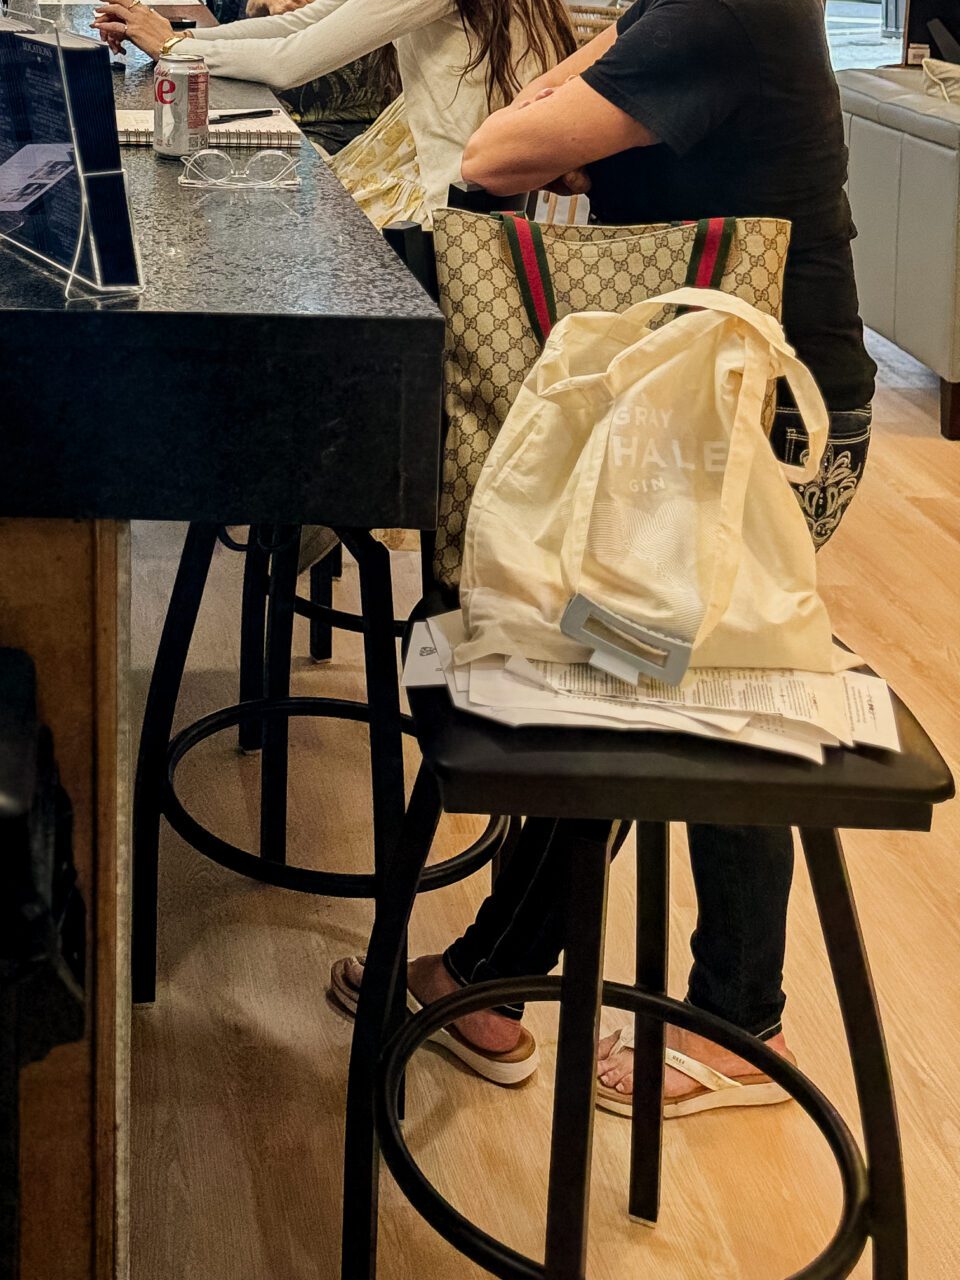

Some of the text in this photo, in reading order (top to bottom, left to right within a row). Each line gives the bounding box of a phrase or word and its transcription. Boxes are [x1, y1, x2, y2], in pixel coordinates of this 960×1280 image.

[613, 406, 673, 428] GRAY
[611, 435, 728, 472] HALE
[629, 477, 666, 493] GIN
